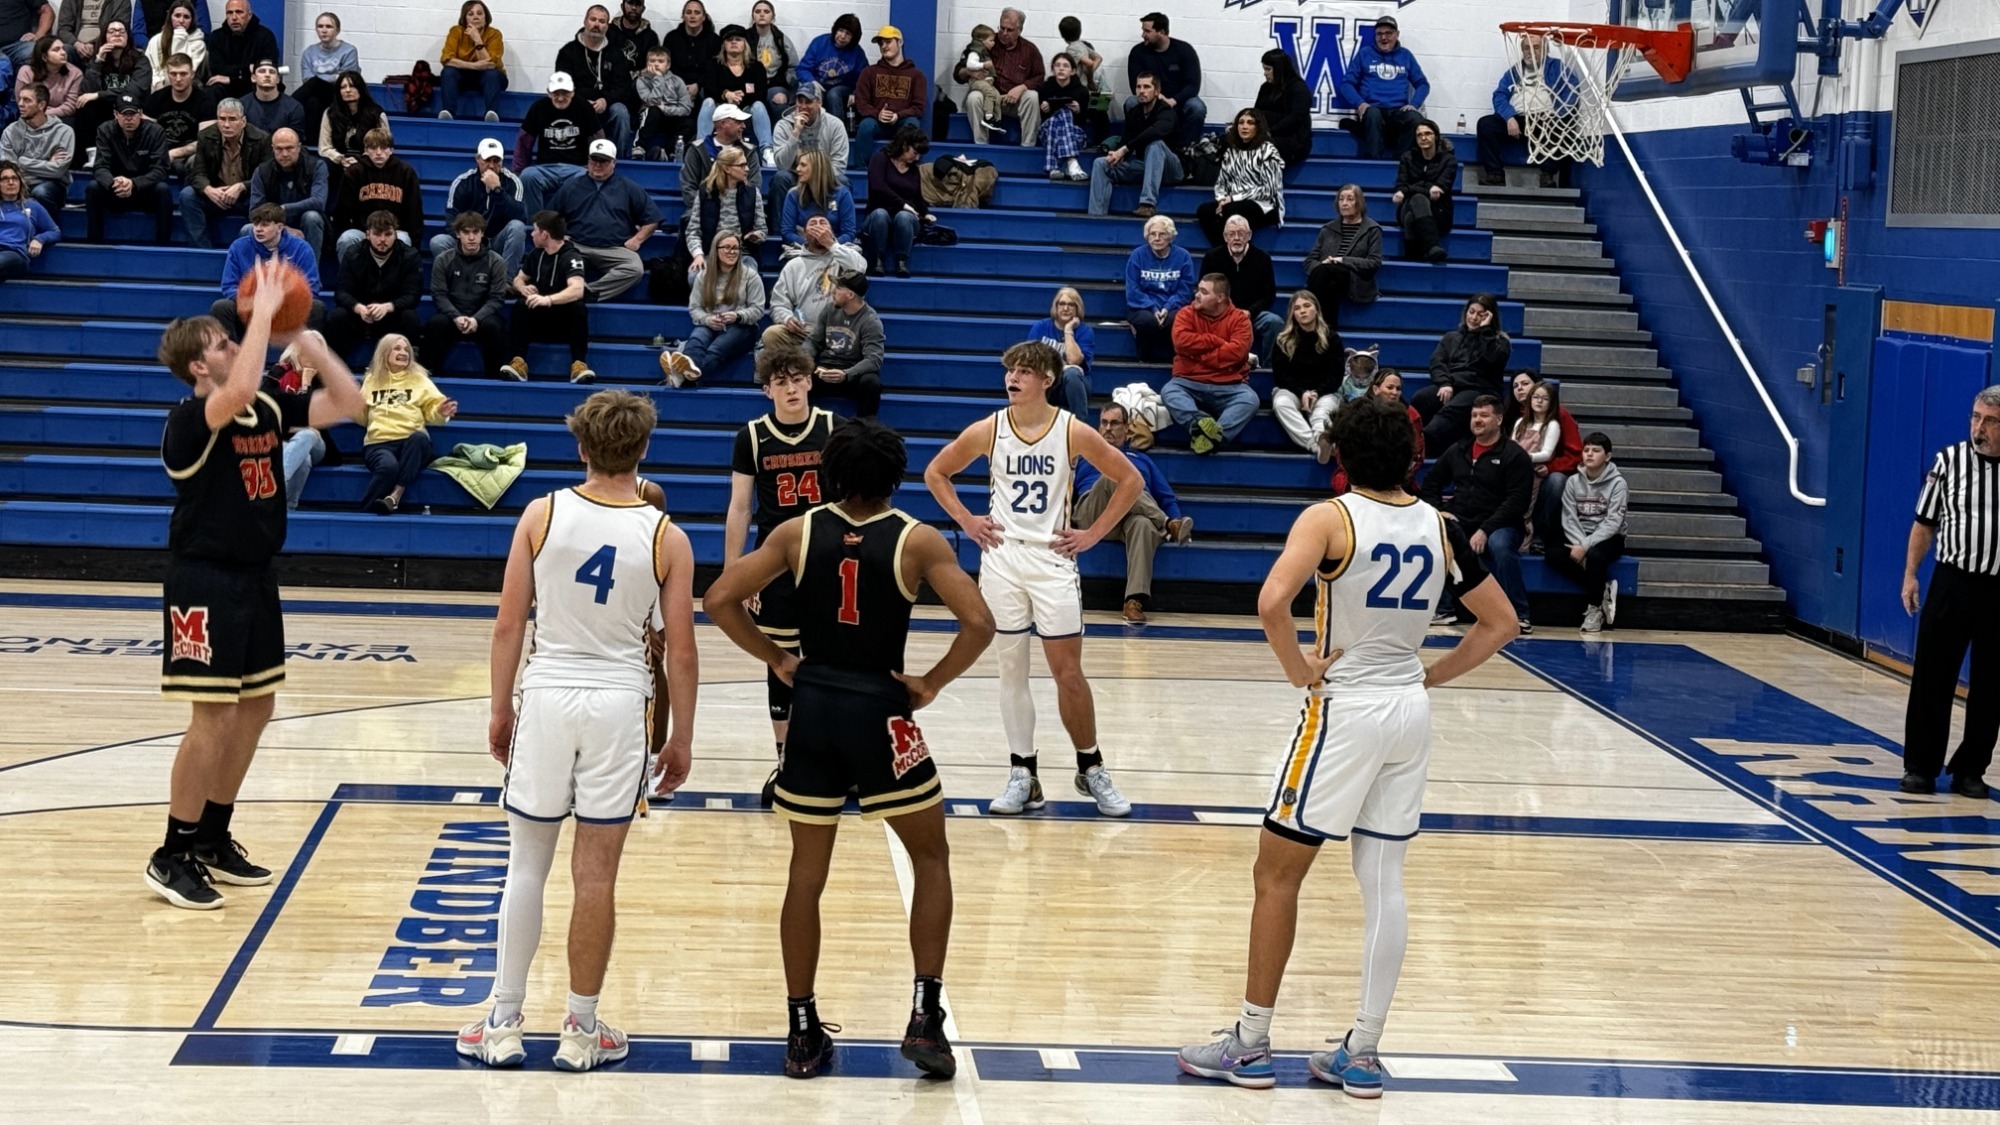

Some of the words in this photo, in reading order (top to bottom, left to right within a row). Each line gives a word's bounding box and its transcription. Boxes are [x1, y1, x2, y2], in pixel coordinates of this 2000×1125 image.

[1270, 15, 1378, 115] W
[1141, 270, 1180, 278] DUKE
[763, 451, 822, 470] CRUSHER
[1006, 455, 1055, 475] LIONS
[776, 470, 821, 506] 24
[1011, 480, 1049, 514] 23
[575, 544, 617, 605] 4
[838, 558, 859, 625] 1
[1366, 542, 1433, 611] 22
[170, 606, 208, 643] M
[887, 716, 924, 756] M
[359, 820, 512, 1007] WINDBER
